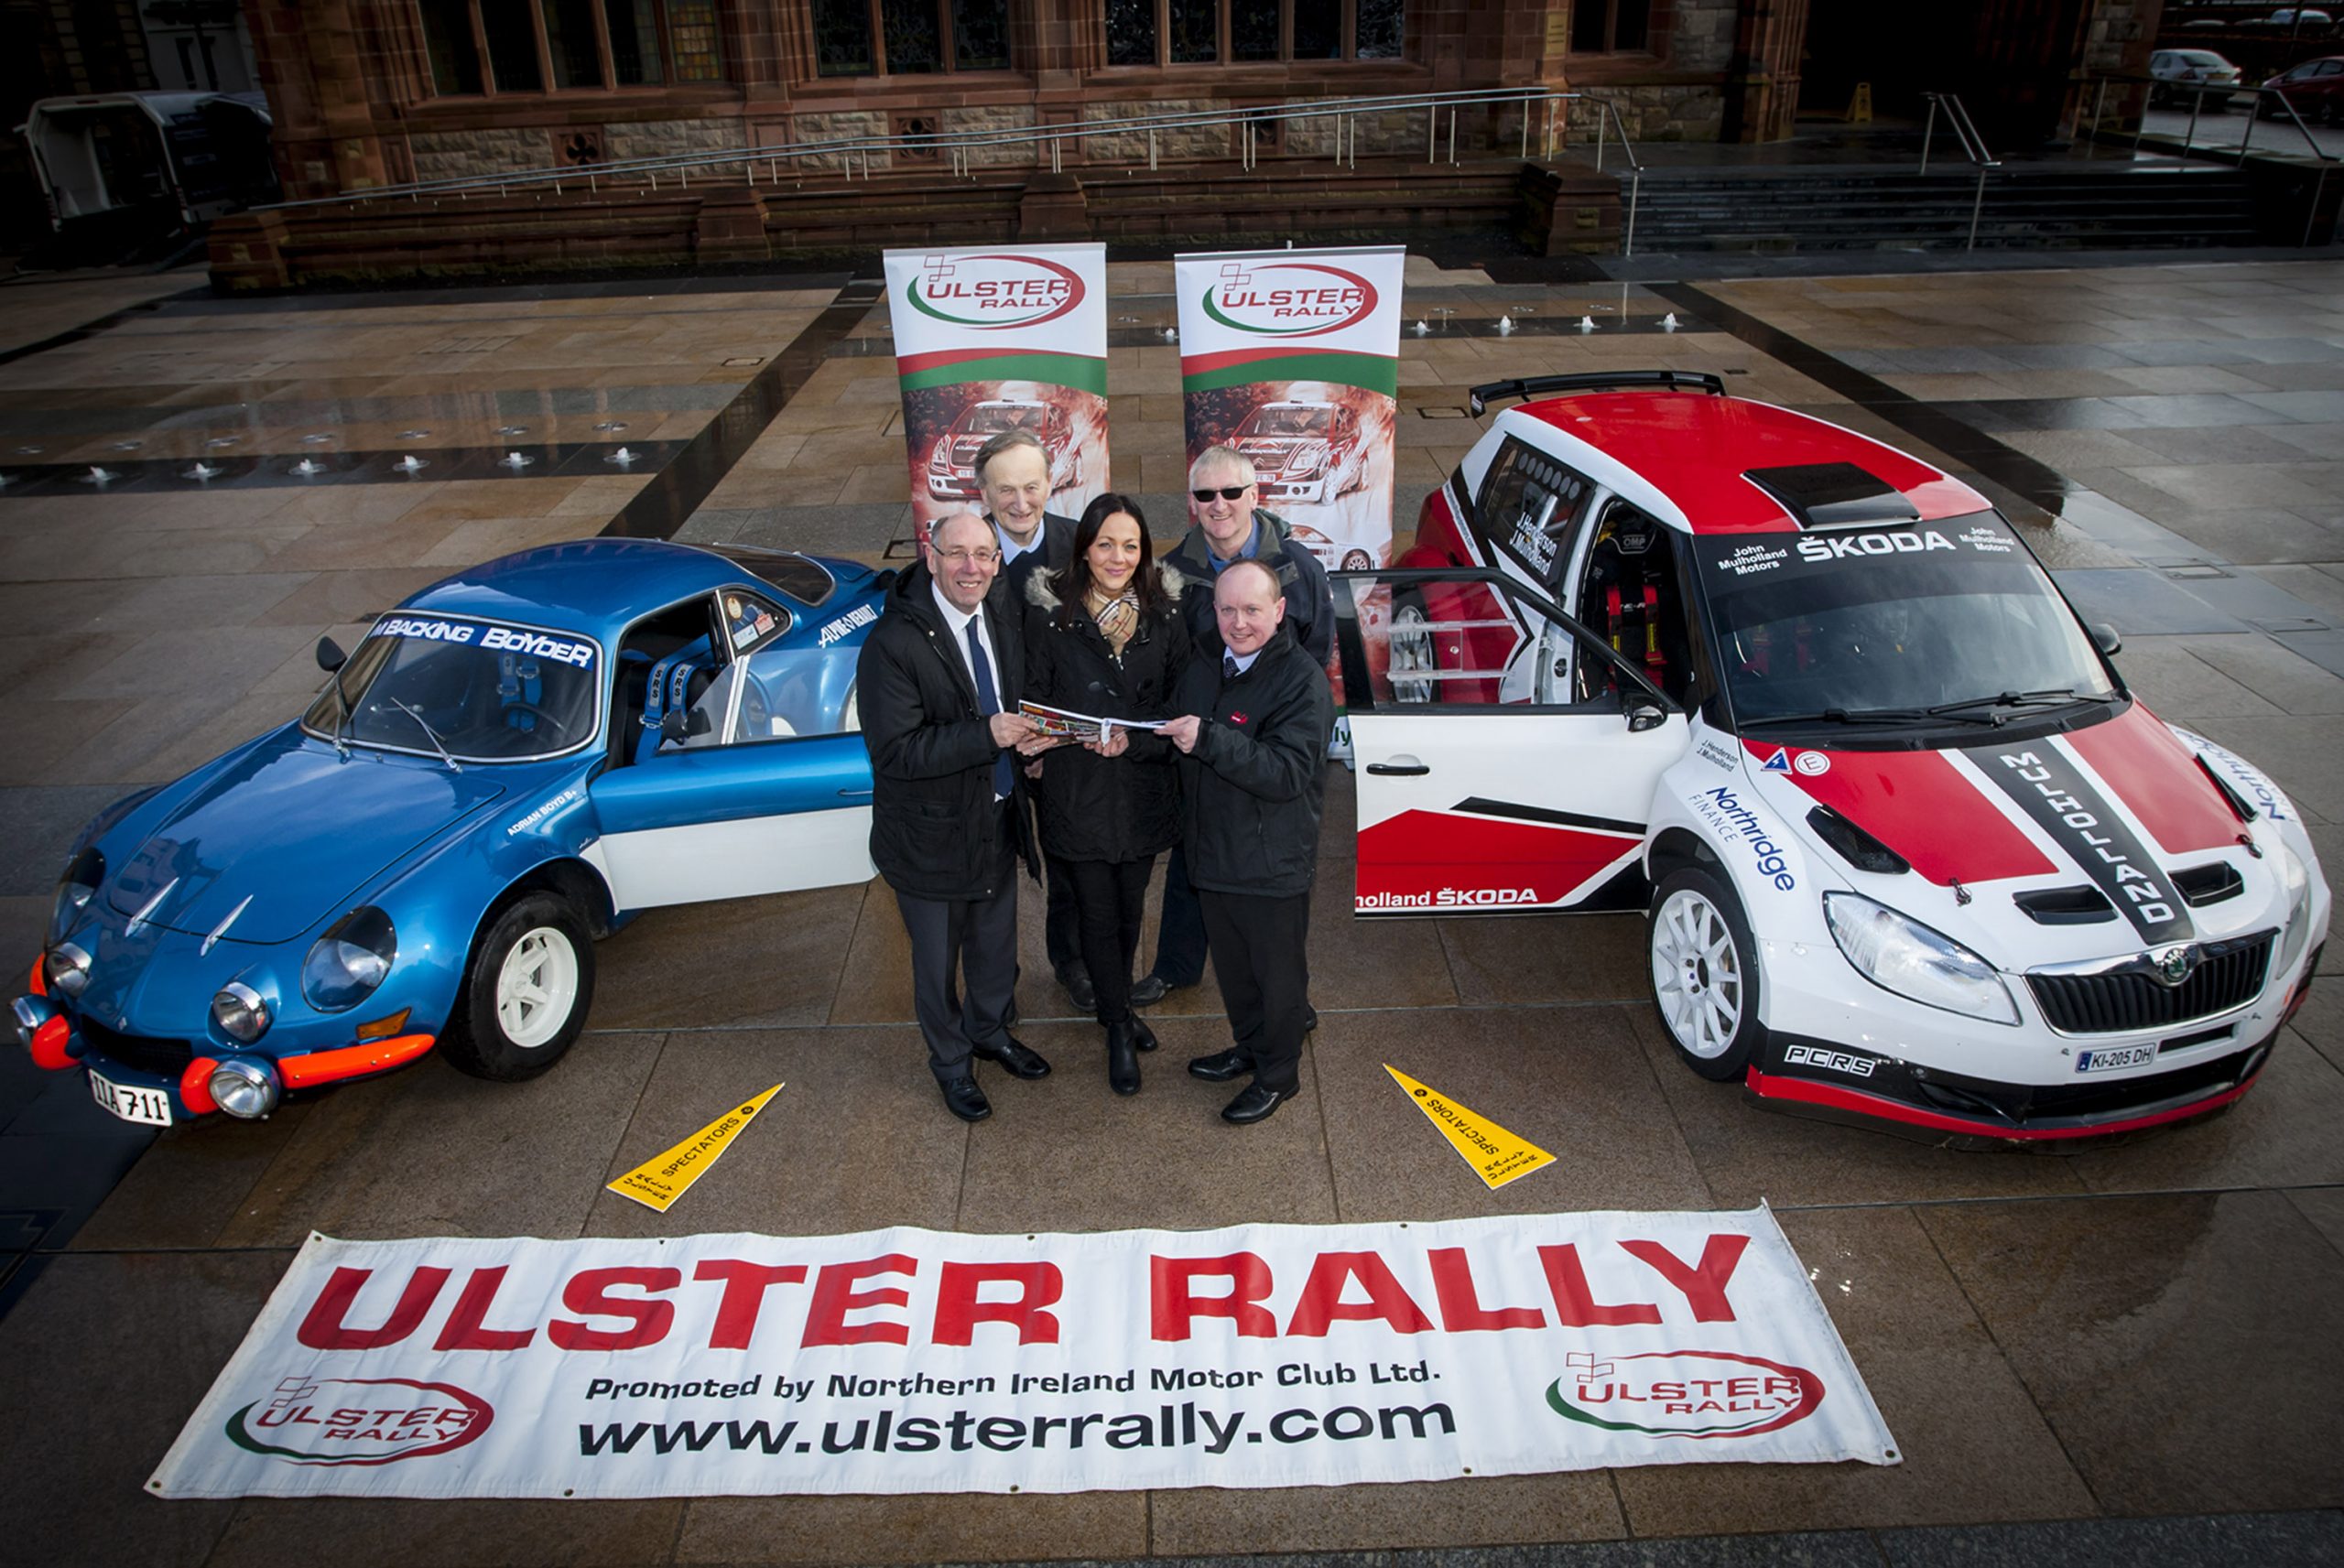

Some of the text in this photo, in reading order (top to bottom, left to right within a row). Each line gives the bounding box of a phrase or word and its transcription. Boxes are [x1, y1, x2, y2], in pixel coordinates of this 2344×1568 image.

[927, 278, 1071, 299] ULSTER
[1221, 287, 1365, 308] ULSTER
[980, 297, 1068, 309] RALLY
[1274, 305, 1361, 318] RALLY
[1718, 548, 1788, 570] Mulholland
[1733, 545, 1765, 557] John
[1796, 531, 1957, 562] ŠKODA
[1735, 560, 1781, 575] Motors
[384, 620, 474, 642] BACKING
[480, 627, 593, 667] BOYDER
[652, 669, 663, 698] SRS
[674, 669, 687, 697] SRS
[507, 811, 541, 836] ADRIAN
[538, 795, 565, 815] BOYD
[1688, 794, 1739, 842] FINANCE
[1706, 786, 1795, 892] Northridge
[2000, 752, 2175, 924] MULHOLLAND
[1436, 887, 1538, 905] ŠKODA
[1785, 1045, 1875, 1076] PCRS
[2132, 1047, 2152, 1063] DH
[119, 1089, 165, 1120] 711
[1427, 1098, 1500, 1156] SPECTATORS
[661, 1117, 740, 1177] SPECTATORS
[1484, 1151, 1525, 1172] RALLY
[1488, 1154, 1538, 1180] ULSTER
[624, 1177, 669, 1201] ULSTER
[635, 1173, 673, 1192] RALLY
[298, 1234, 1751, 1352] ULSTER RALLY
[585, 1360, 1441, 1402] Promoted by Northern Ireland Motor Club Ltd.
[1577, 1376, 1801, 1403] ULSTER
[255, 1405, 478, 1427] ULSTER
[1665, 1397, 1801, 1414] RALLY
[323, 1427, 462, 1442] RALLY
[579, 1401, 1457, 1455] www.ulsterrally.com
